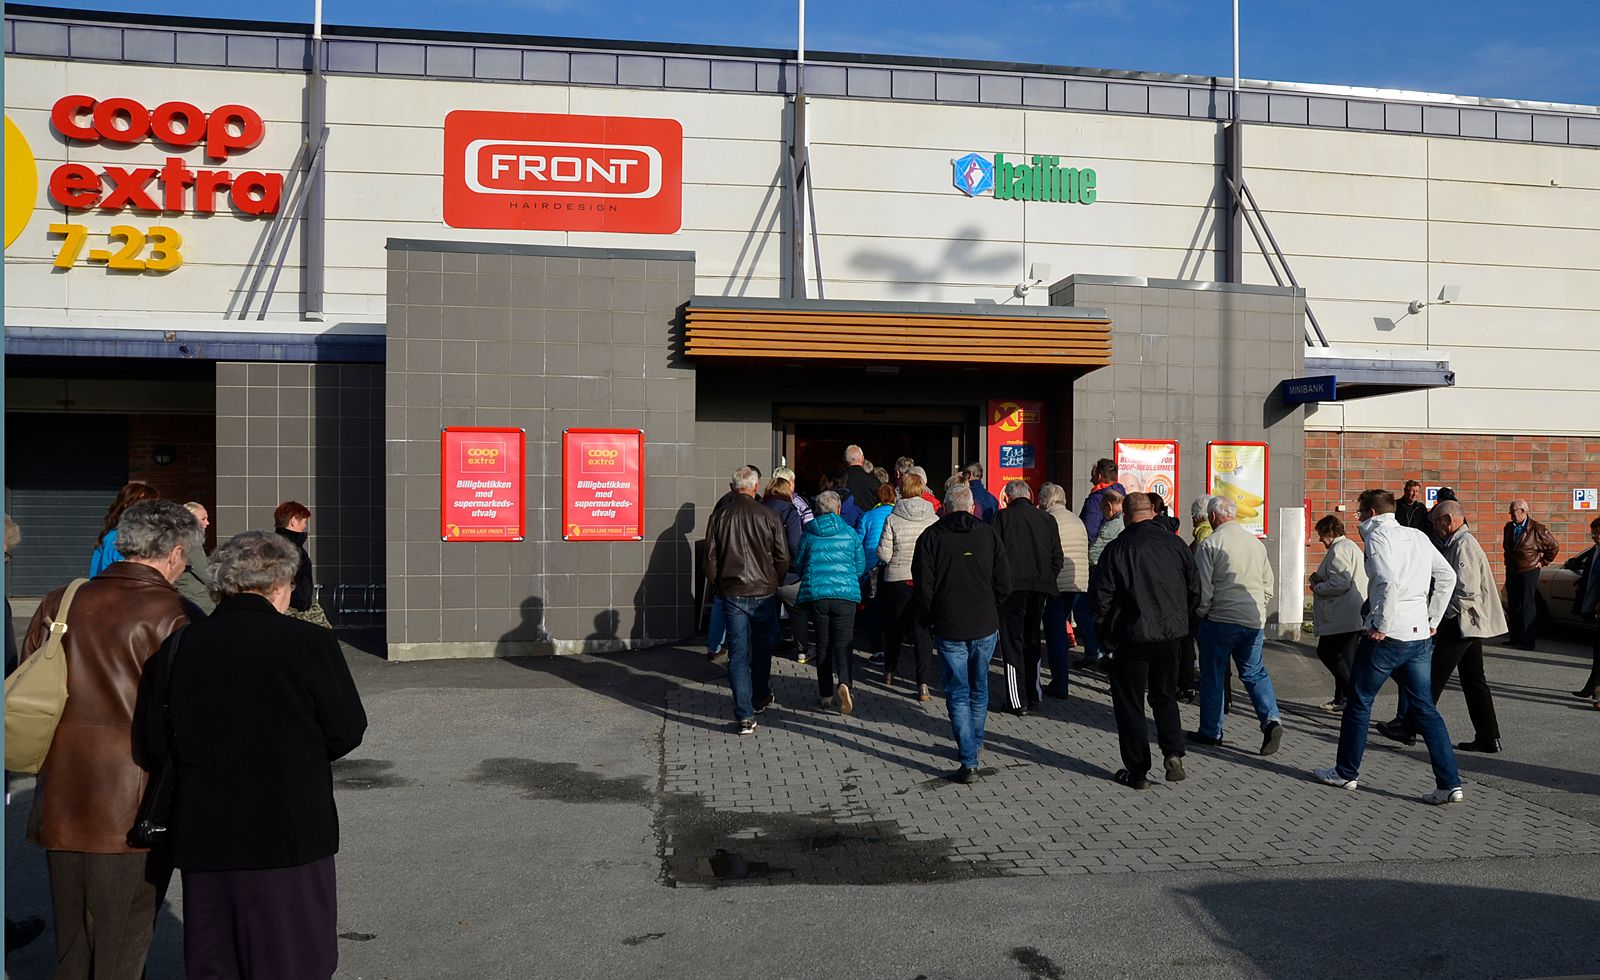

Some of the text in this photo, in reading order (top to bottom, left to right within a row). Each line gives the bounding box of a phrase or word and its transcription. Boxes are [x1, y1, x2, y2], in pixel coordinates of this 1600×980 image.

[51, 95, 265, 161] coop
[491, 154, 638, 184] FRONT
[994, 153, 1097, 204] bailine
[50, 157, 283, 215] extra
[509, 201, 618, 212] HAIRDESIGN
[49, 223, 183, 272] 7-23
[467, 448, 499, 458] coop
[588, 449, 618, 459] coop
[467, 457, 496, 465] extra
[588, 458, 615, 466] extra
[456, 480, 512, 489] Billigbutikken
[577, 480, 631, 490] Billigbutikken
[474, 490, 494, 498] med
[595, 490, 613, 498] med
[1576, 490, 1584, 500] P
[453, 500, 515, 509] supermarkeds-
[574, 500, 633, 508] supermarkeds-
[471, 509, 497, 518] utvalg
[591, 509, 616, 518] utvalg
